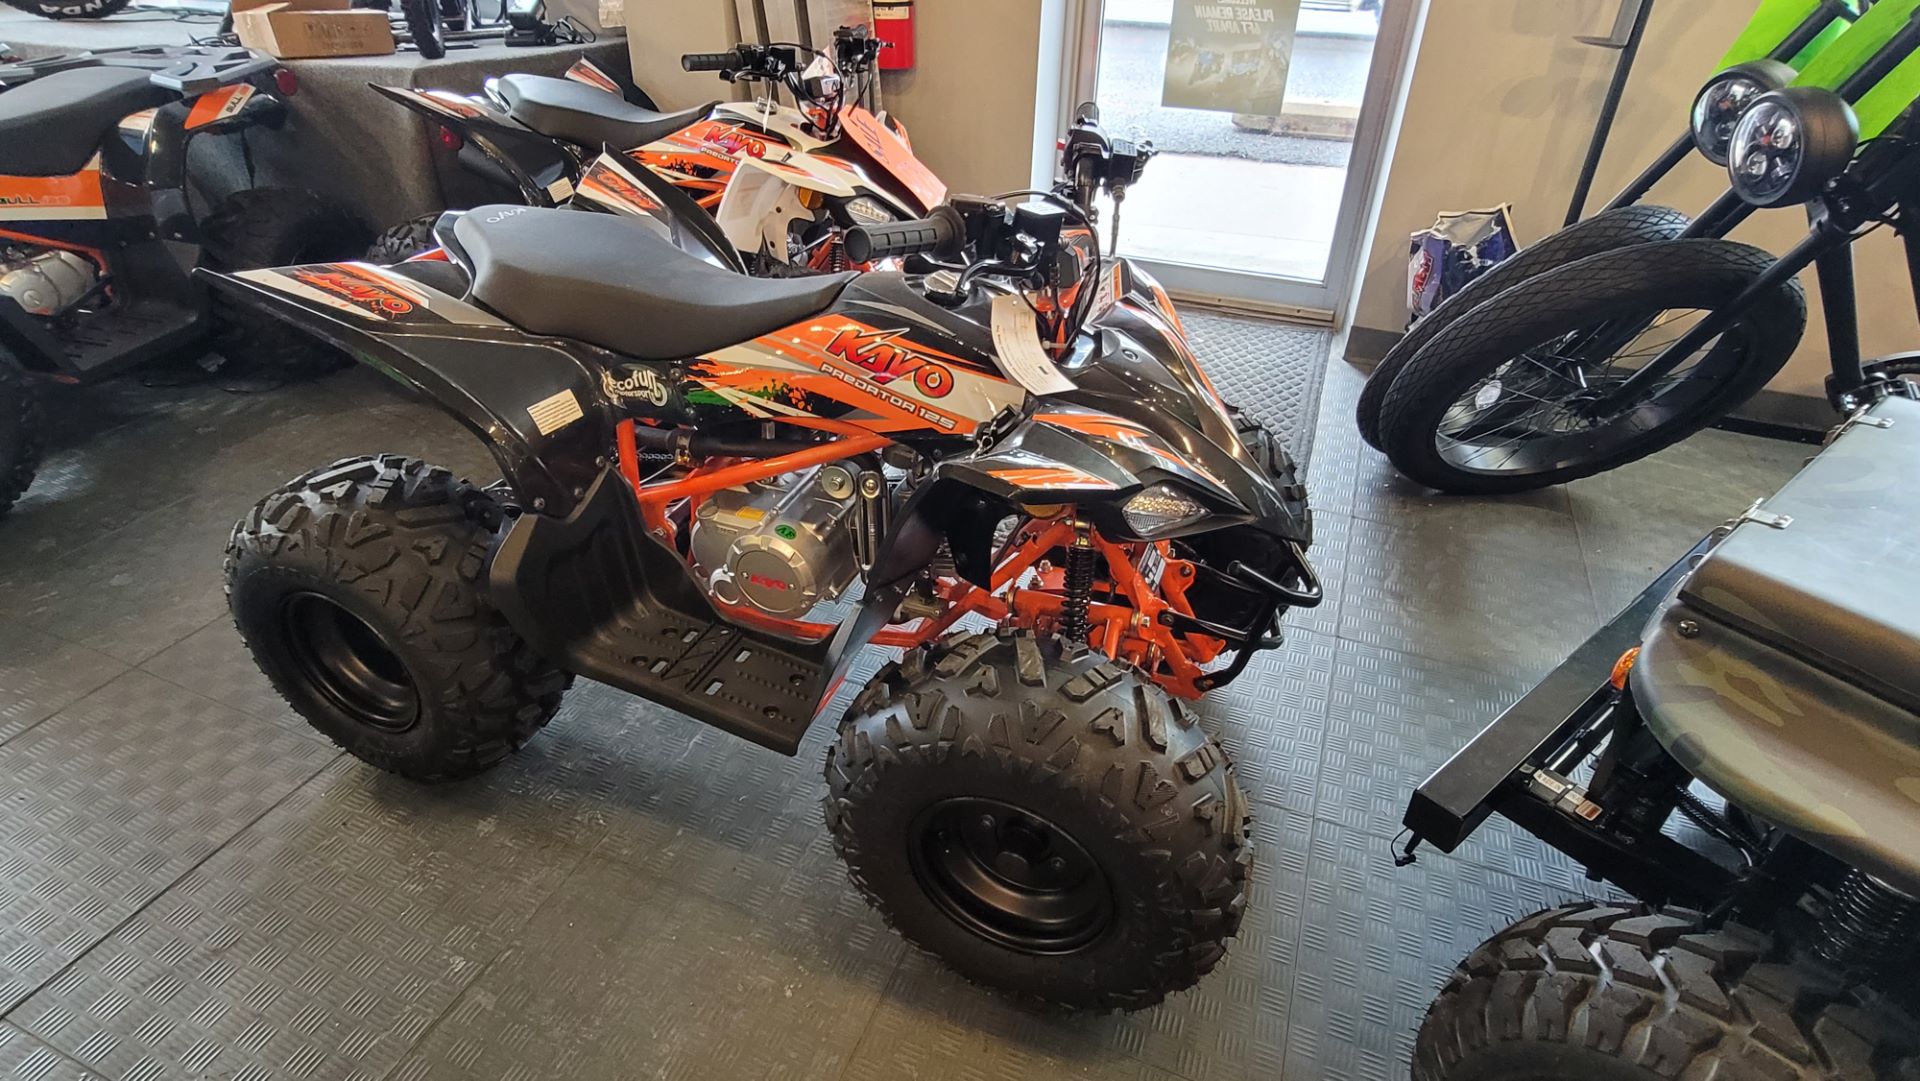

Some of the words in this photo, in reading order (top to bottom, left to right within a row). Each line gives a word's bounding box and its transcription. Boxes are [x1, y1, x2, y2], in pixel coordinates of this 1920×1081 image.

[703, 122, 767, 160] KAYO
[486, 207, 527, 223] KAYO
[824, 327, 954, 399] KAYO
[819, 361, 916, 414] PREDATOR
[916, 406, 956, 430] 125
